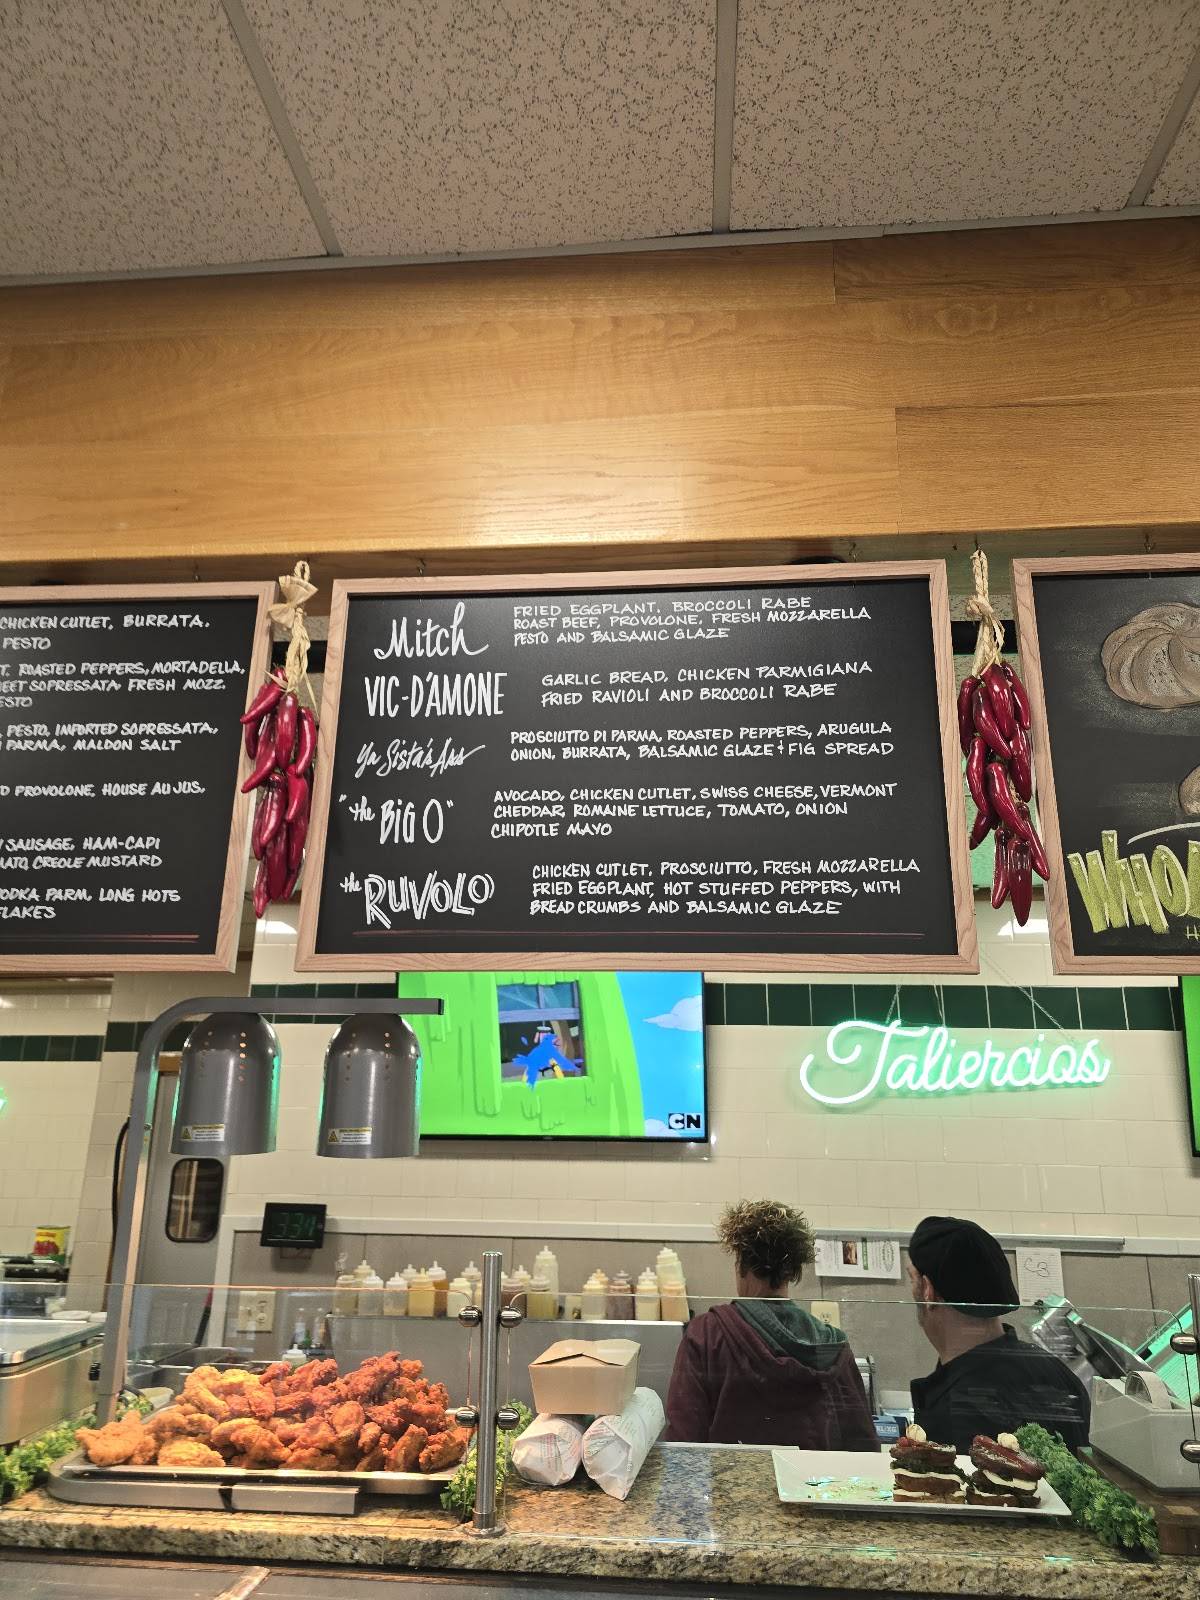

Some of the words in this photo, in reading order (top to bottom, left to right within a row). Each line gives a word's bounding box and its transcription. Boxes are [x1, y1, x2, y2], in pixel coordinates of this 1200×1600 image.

[514, 606, 561, 617] FRIED
[672, 599, 750, 613] BROCCOLI
[762, 597, 811, 609] RABE
[0, 616, 57, 629] CHICKEN
[514, 617, 557, 629] ROAST
[562, 617, 600, 628] BEEF,
[711, 611, 760, 623] FRESH
[766, 606, 871, 622] MOZZARELLA
[373, 601, 490, 661] Mitch
[514, 631, 548, 646] PESTO
[557, 632, 585, 643] AND
[591, 630, 669, 642] BALSAMIC
[674, 628, 730, 639] GLAZE
[3, 637, 51, 649] PESTO
[542, 674, 601, 686] GARLIC
[678, 668, 749, 681] CHICKEN
[756, 662, 872, 678] PARMIGIANA
[0, 680, 28, 692] EET
[128, 679, 175, 691] FRESH
[541, 692, 582, 707] FRIED
[592, 689, 649, 703] RAVIOLI
[659, 689, 693, 701] AND
[700, 686, 773, 700] BROCCOLI
[783, 684, 837, 697] RABE
[511, 730, 589, 743] PROSCIUTTO
[594, 730, 606, 742] DI
[667, 729, 733, 740] ROASTED
[740, 725, 812, 740] PEPPERS,
[817, 722, 891, 736] ARUGULA
[73, 739, 132, 750] MALDON
[140, 739, 181, 750] SALT
[562, 746, 630, 760] BURRATA,
[638, 745, 717, 758] BALSAMIC
[724, 744, 774, 756] GLAZE
[789, 743, 815, 755] FIG
[825, 743, 893, 755] SPREAD
[102, 783, 147, 796] HOUSE
[151, 782, 171, 795] AU
[570, 789, 633, 800] CHICKEN
[700, 786, 748, 798] SWISS
[820, 783, 897, 797] VERMONT
[574, 804, 639, 817] ROMAINE
[643, 805, 711, 818] LETTUCE,
[717, 803, 789, 817] TOMATO,
[796, 802, 847, 815] ONION
[491, 823, 559, 838] CHIPOTLE
[567, 823, 612, 835] MAYO
[83, 836, 160, 850] HAM-CAPI
[32, 856, 86, 869] CREOLE
[85, 855, 162, 867] MUSTARD
[533, 863, 590, 880] CHICKEN
[764, 861, 811, 874] FRESH
[817, 858, 920, 873] MOZZARELLA
[340, 871, 363, 894] the
[533, 882, 572, 897] FRIED
[664, 882, 693, 895] HOT
[699, 882, 774, 895] STUFFED
[781, 880, 857, 896] PEPPERS,
[863, 880, 900, 894] WITH
[99, 888, 135, 902] LONG
[142, 890, 180, 902] HOTS
[530, 900, 574, 915] BREAD
[578, 901, 641, 914] CRUMBS
[648, 900, 679, 913] AND
[686, 901, 771, 914] BALSAMIC
[776, 901, 842, 914] GLAZE
[799, 1018, 1113, 1106] Taliercios
[667, 1112, 701, 1130] CN
